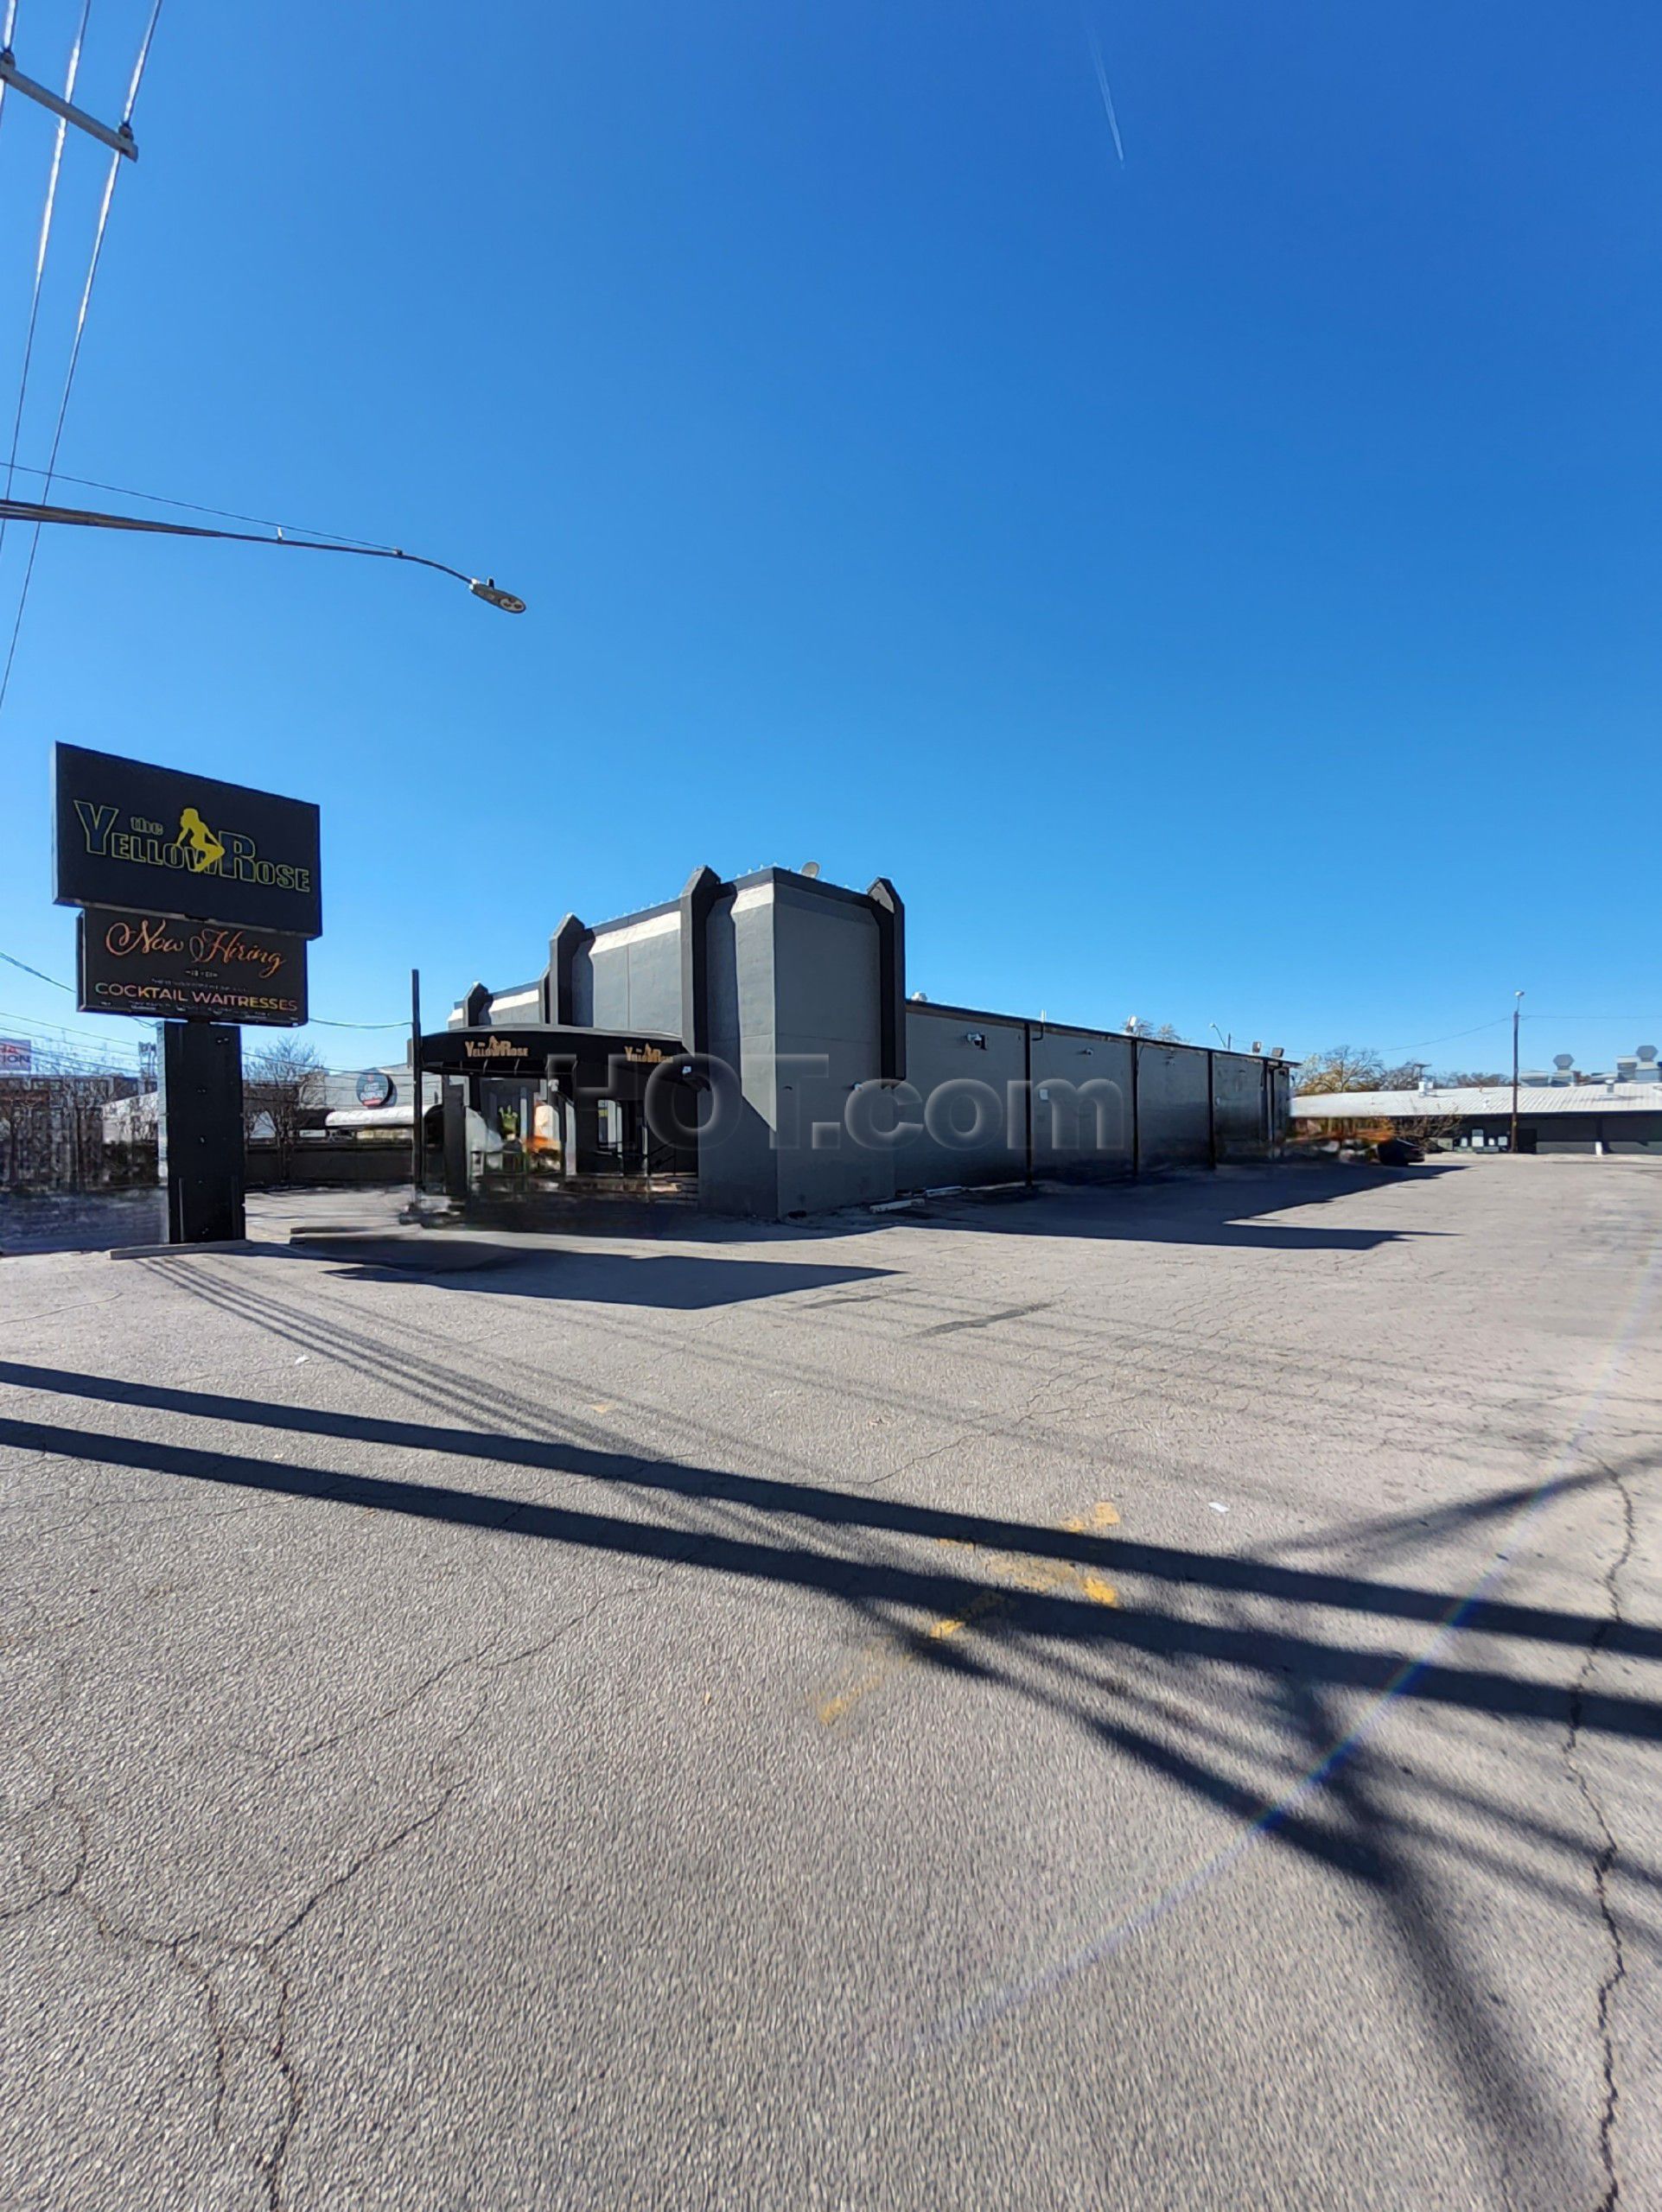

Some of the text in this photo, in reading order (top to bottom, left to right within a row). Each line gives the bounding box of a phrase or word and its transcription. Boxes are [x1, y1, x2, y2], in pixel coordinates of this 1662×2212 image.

[131, 817, 163, 835] the
[219, 830, 310, 893] ROSE
[105, 919, 285, 978] Now Hiring
[95, 982, 188, 1001] COCKTAIL
[192, 991, 298, 1011] WAITRESSES
